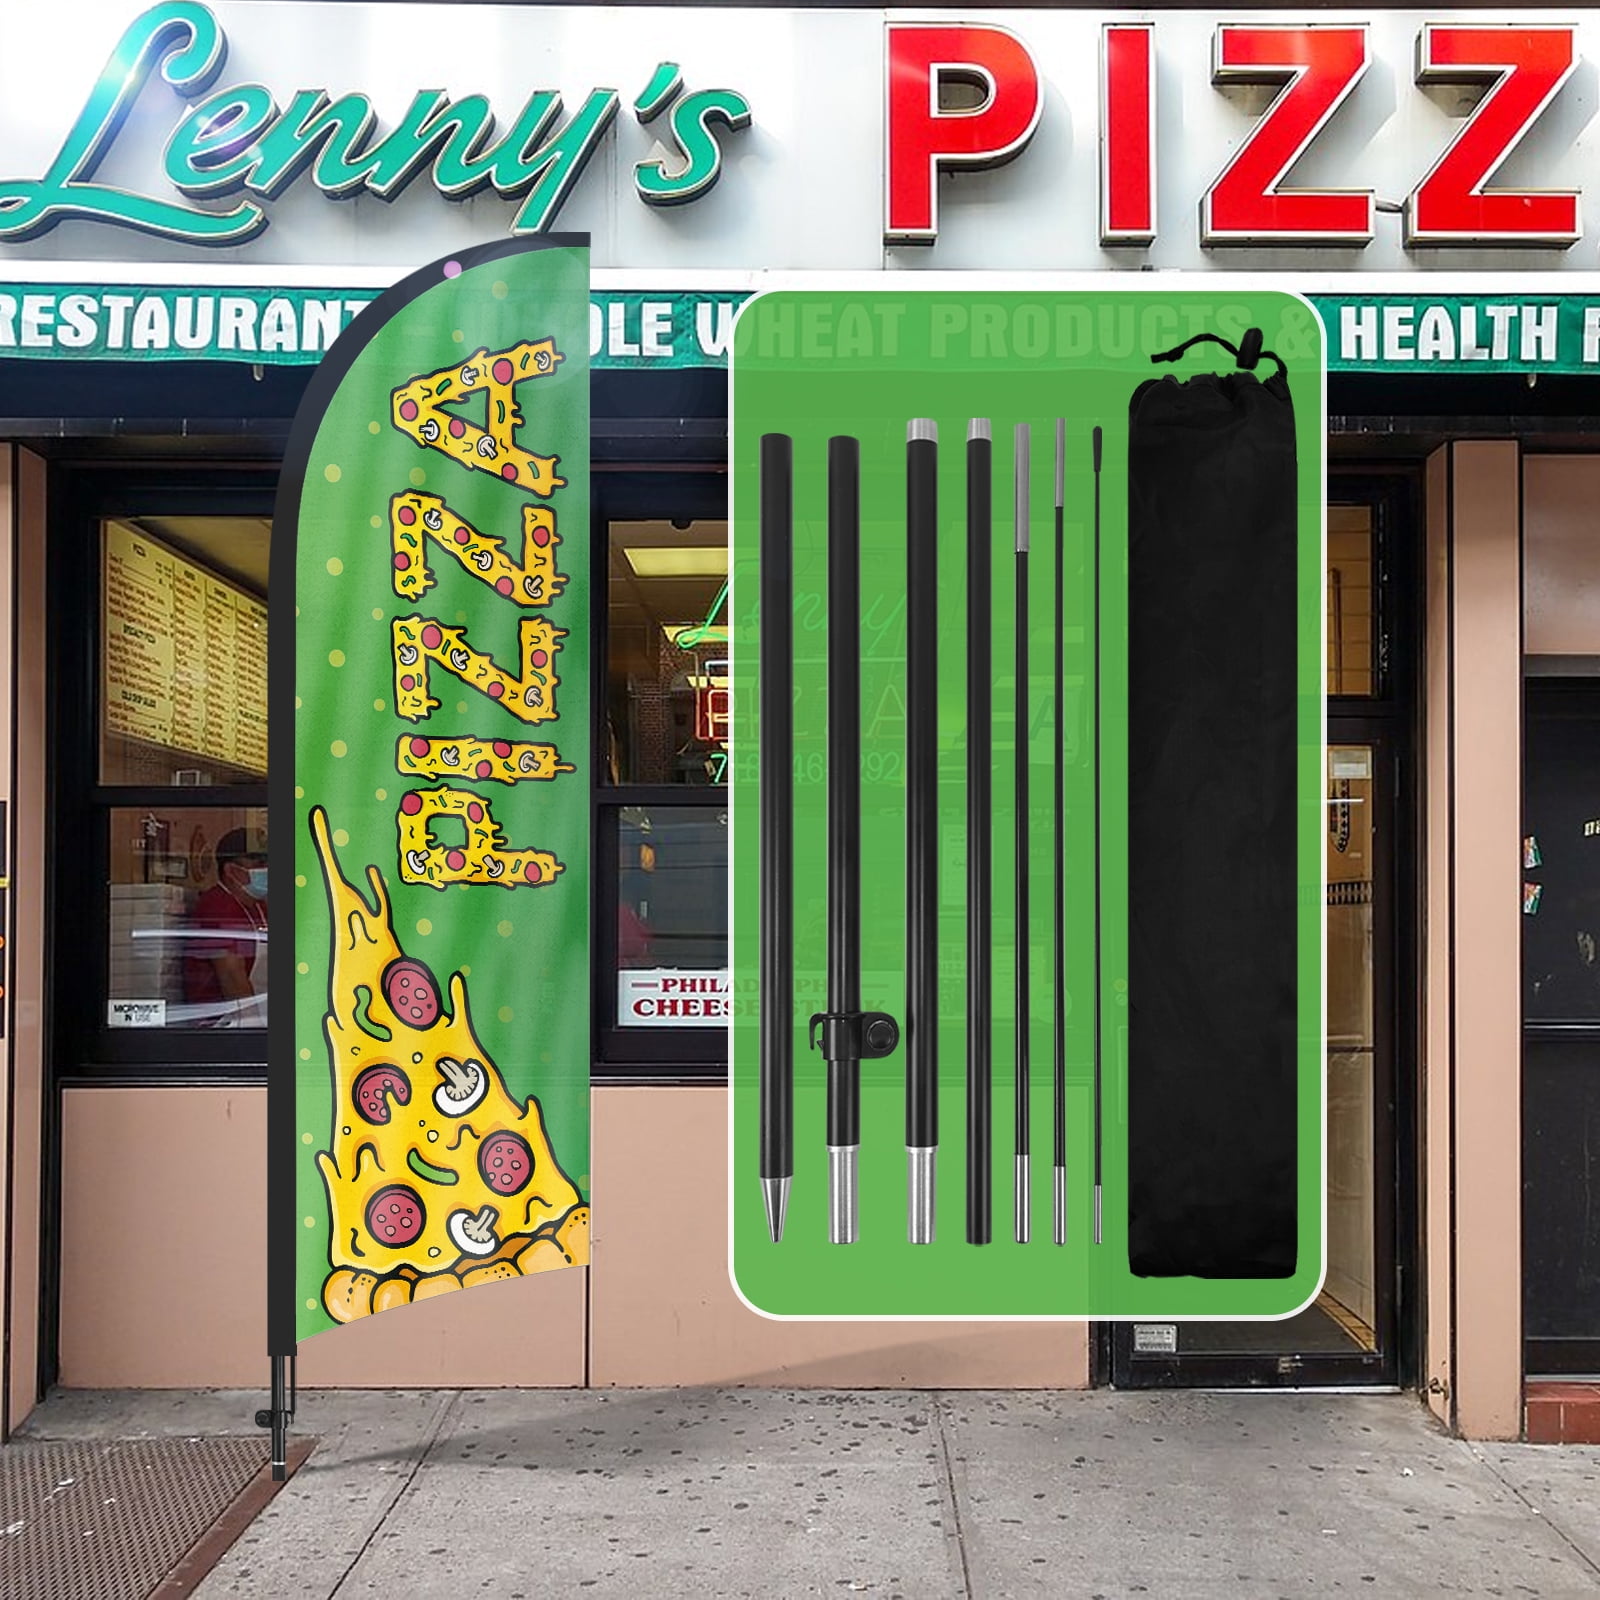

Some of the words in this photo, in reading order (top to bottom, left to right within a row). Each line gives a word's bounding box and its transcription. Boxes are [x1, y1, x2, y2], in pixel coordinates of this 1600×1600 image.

[0, 1, 752, 245] Lenny's
[695, 301, 906, 359] WHEAT
[1340, 305, 1558, 361] HEALTH
[389, 335, 577, 890] PIZZA
